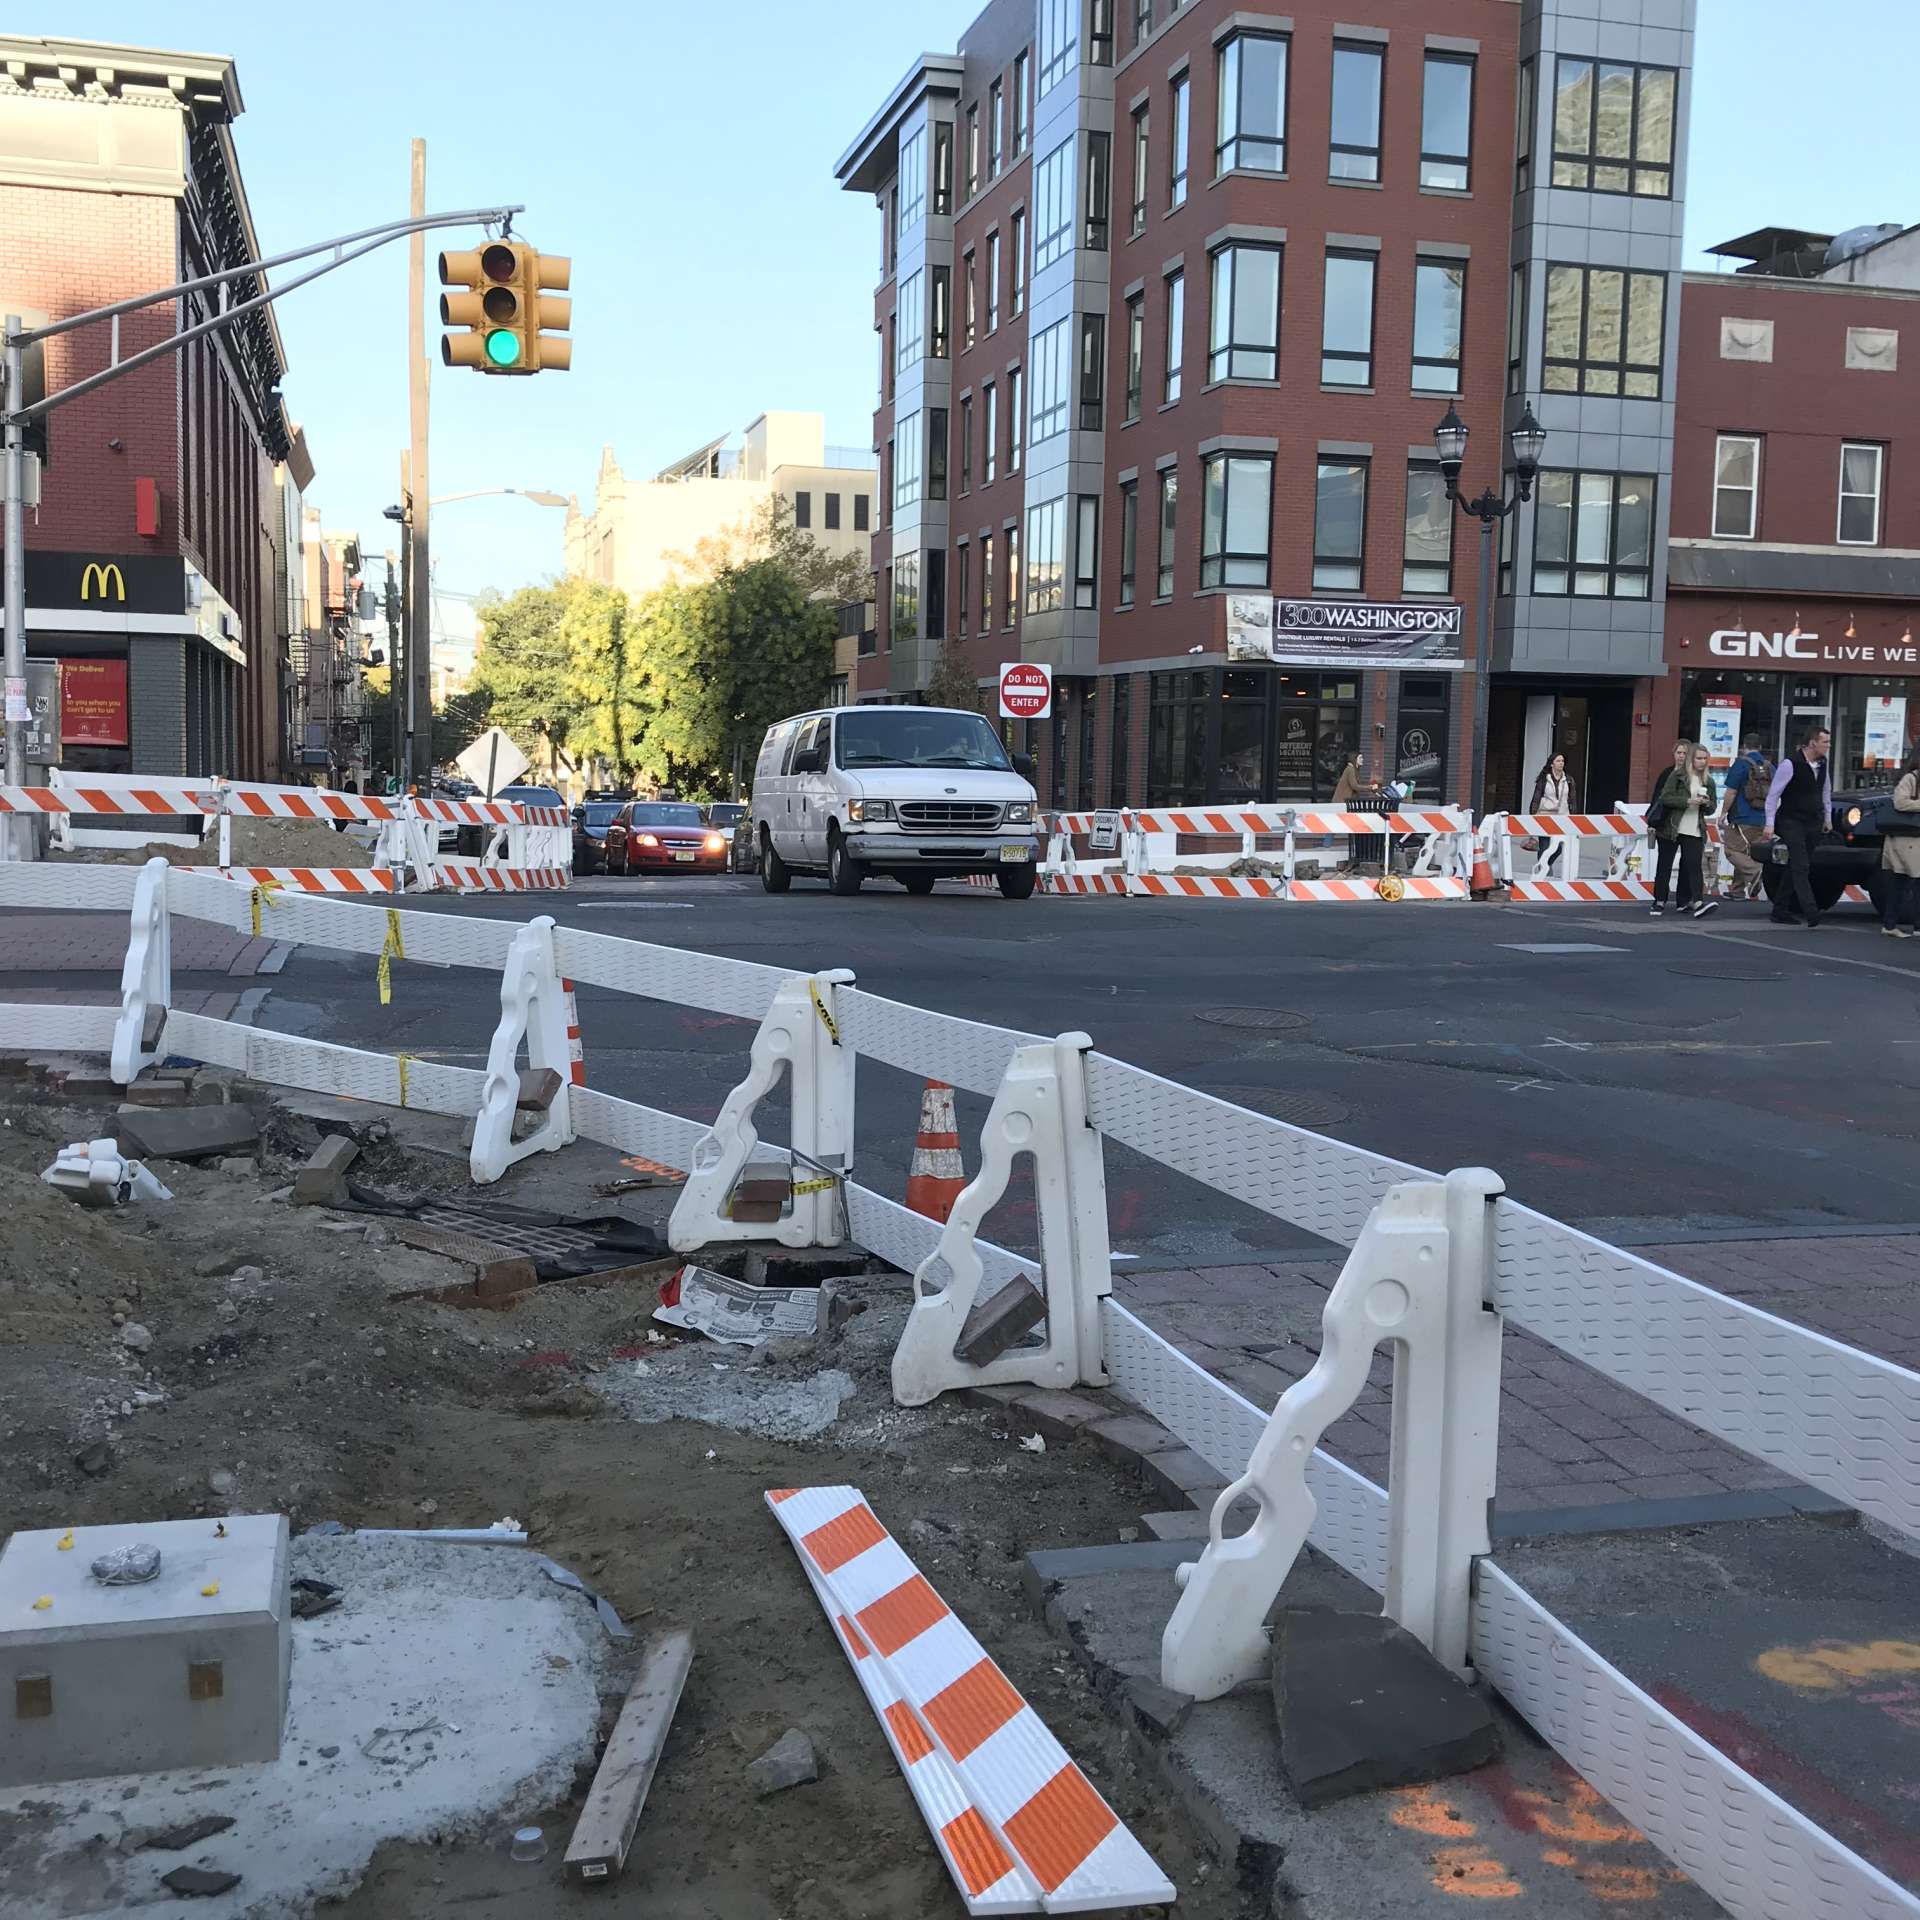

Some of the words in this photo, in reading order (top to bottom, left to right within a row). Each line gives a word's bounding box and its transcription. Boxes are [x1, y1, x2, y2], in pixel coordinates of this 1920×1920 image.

[1709, 630, 1819, 659] GNC
[1824, 646, 1875, 660] LIVE
[1883, 648, 1917, 662] WE
[1008, 674, 1021, 683] DO
[1025, 675, 1043, 684] NOT
[1011, 698, 1040, 707] ENTER
